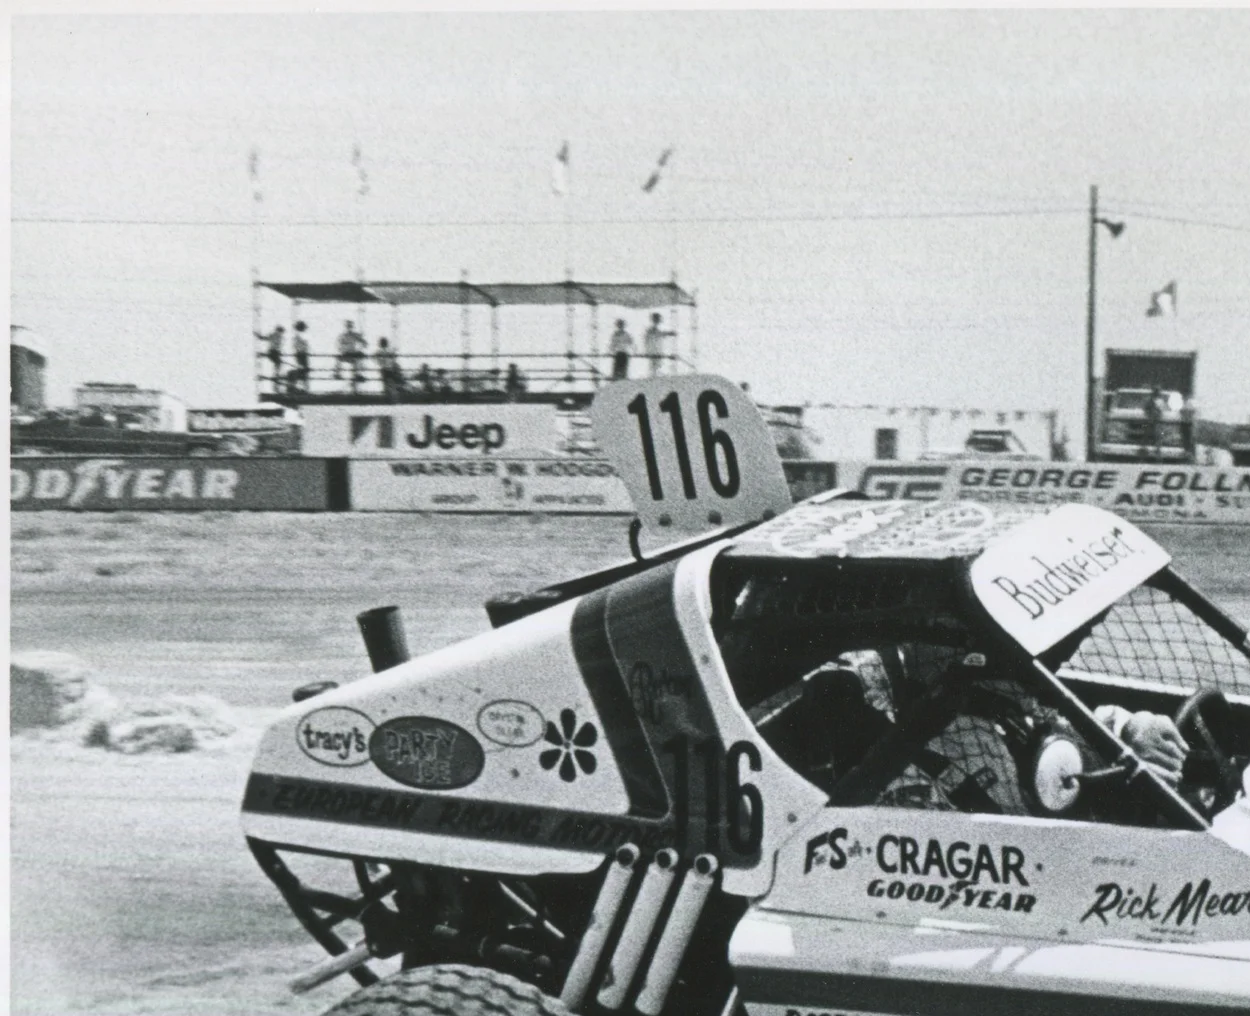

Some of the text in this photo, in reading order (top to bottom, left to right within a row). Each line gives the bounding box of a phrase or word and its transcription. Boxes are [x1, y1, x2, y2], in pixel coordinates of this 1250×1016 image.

[406, 415, 506, 453] Jeep
[627, 389, 741, 501] 116
[958, 489, 1085, 504] PORSCHE
[1114, 492, 1185, 506] AUDI
[960, 467, 1118, 489] GEORGE
[991, 527, 1135, 620] Budweiser
[303, 723, 367, 760] tracy's
[383, 718, 459, 765] PARTY
[663, 734, 764, 856] 116
[876, 834, 1030, 887] CRAGAR
[866, 878, 1038, 913] GOODYEAR
[1079, 882, 1162, 925] Rick
